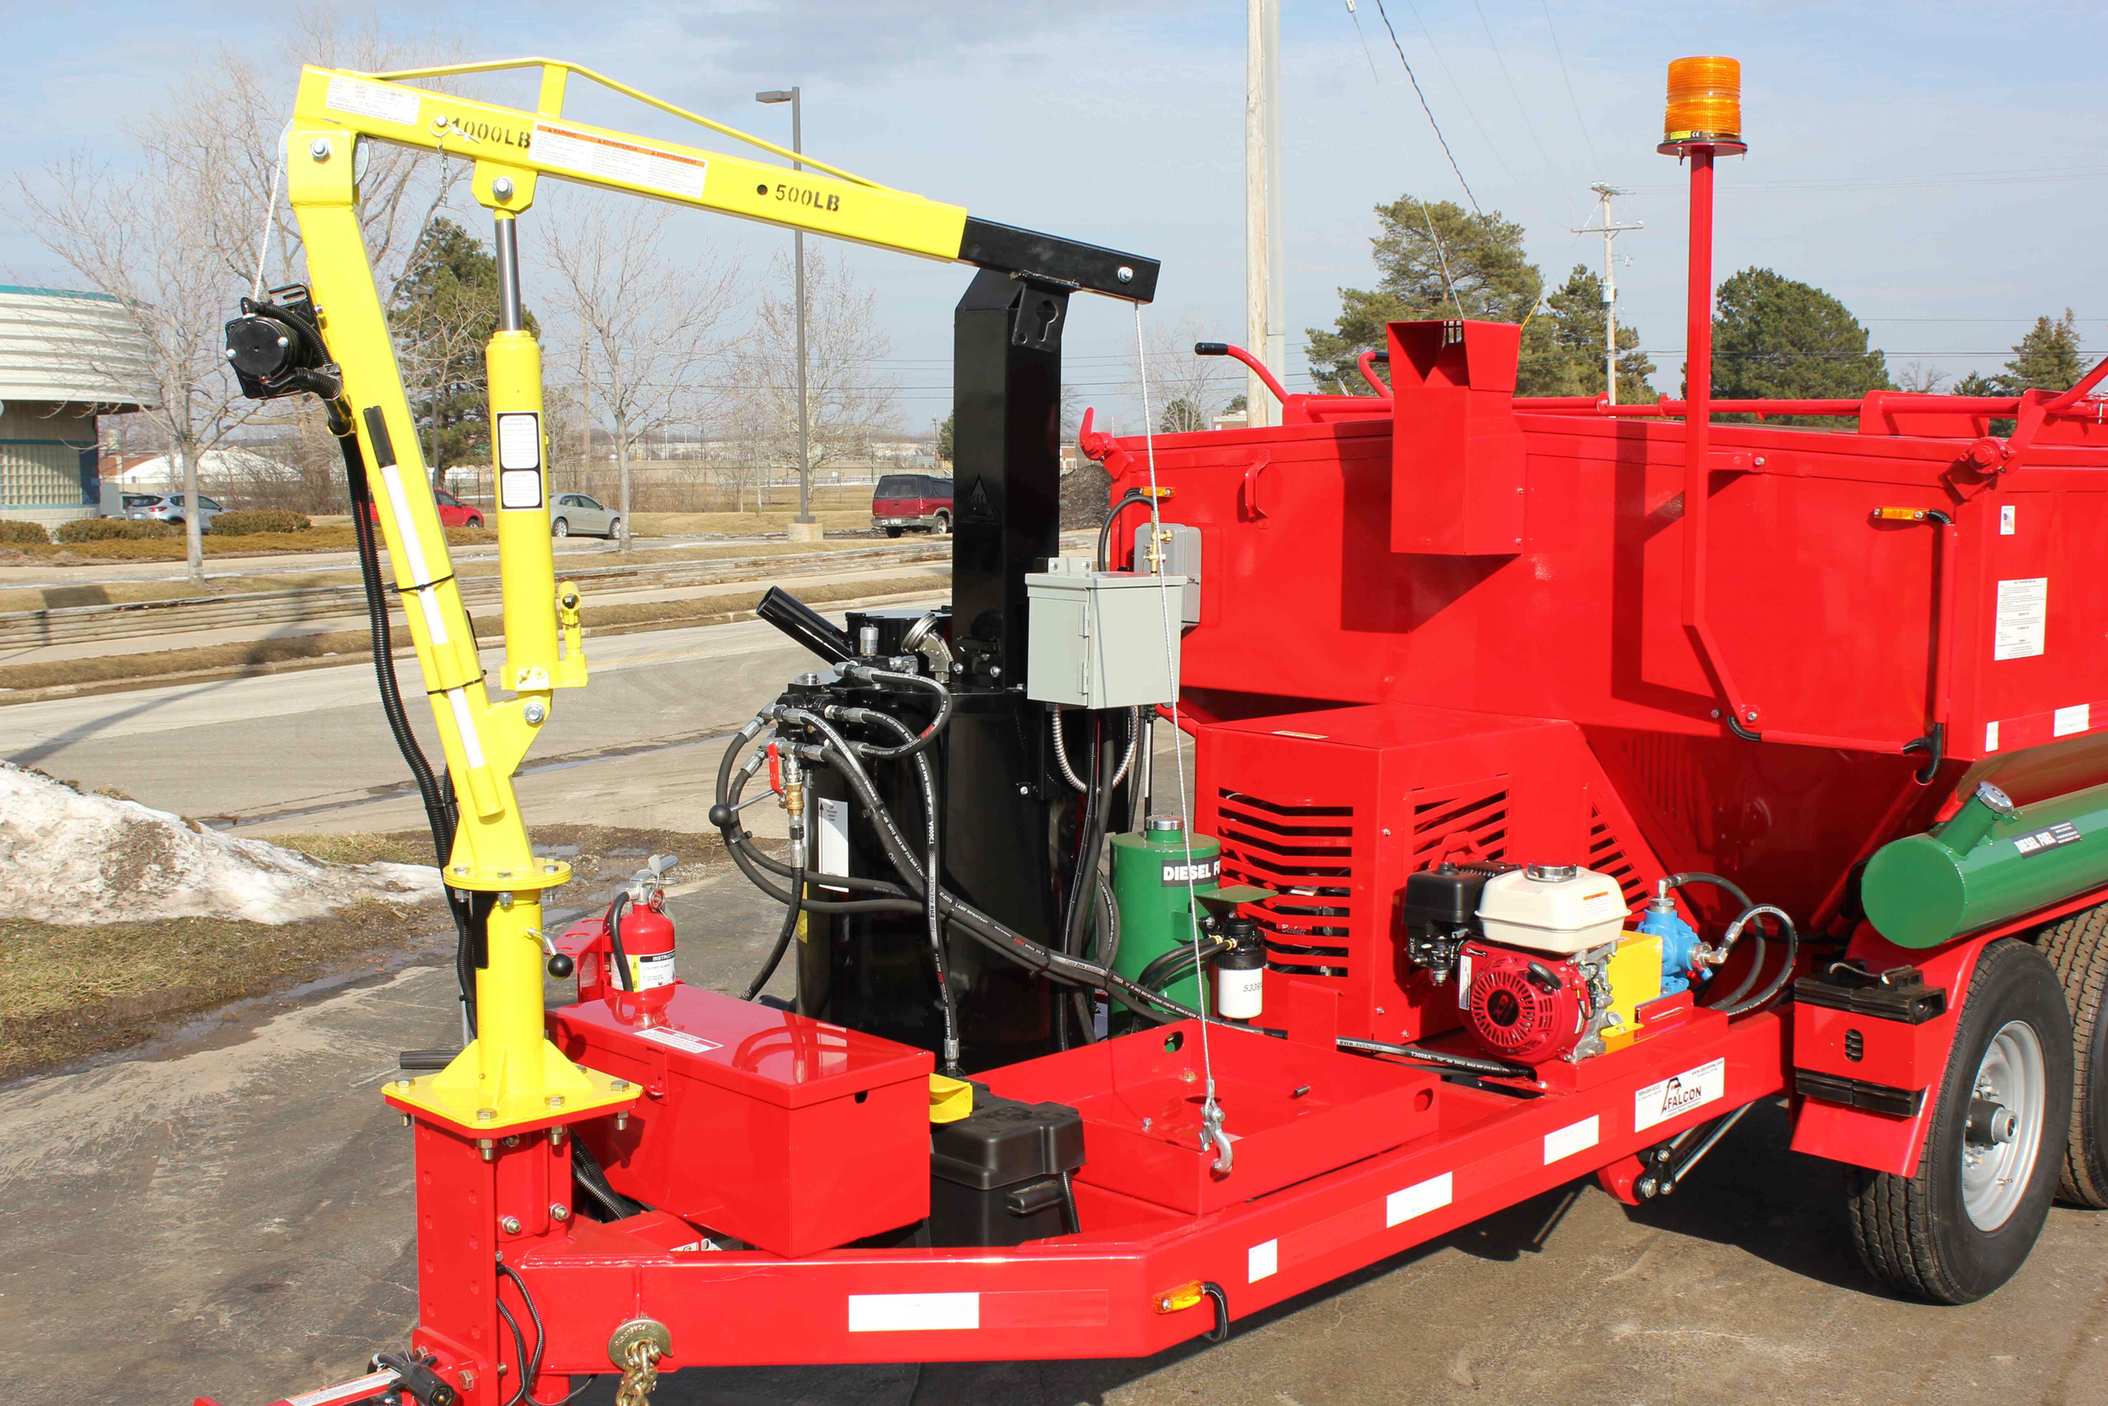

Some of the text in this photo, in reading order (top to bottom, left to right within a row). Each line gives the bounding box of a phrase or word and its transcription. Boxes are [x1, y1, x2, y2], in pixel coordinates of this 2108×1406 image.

[775, 184, 840, 212] 500LB
[1163, 864, 1212, 881] DIESEL
[1667, 1086, 1702, 1109] FALCON
